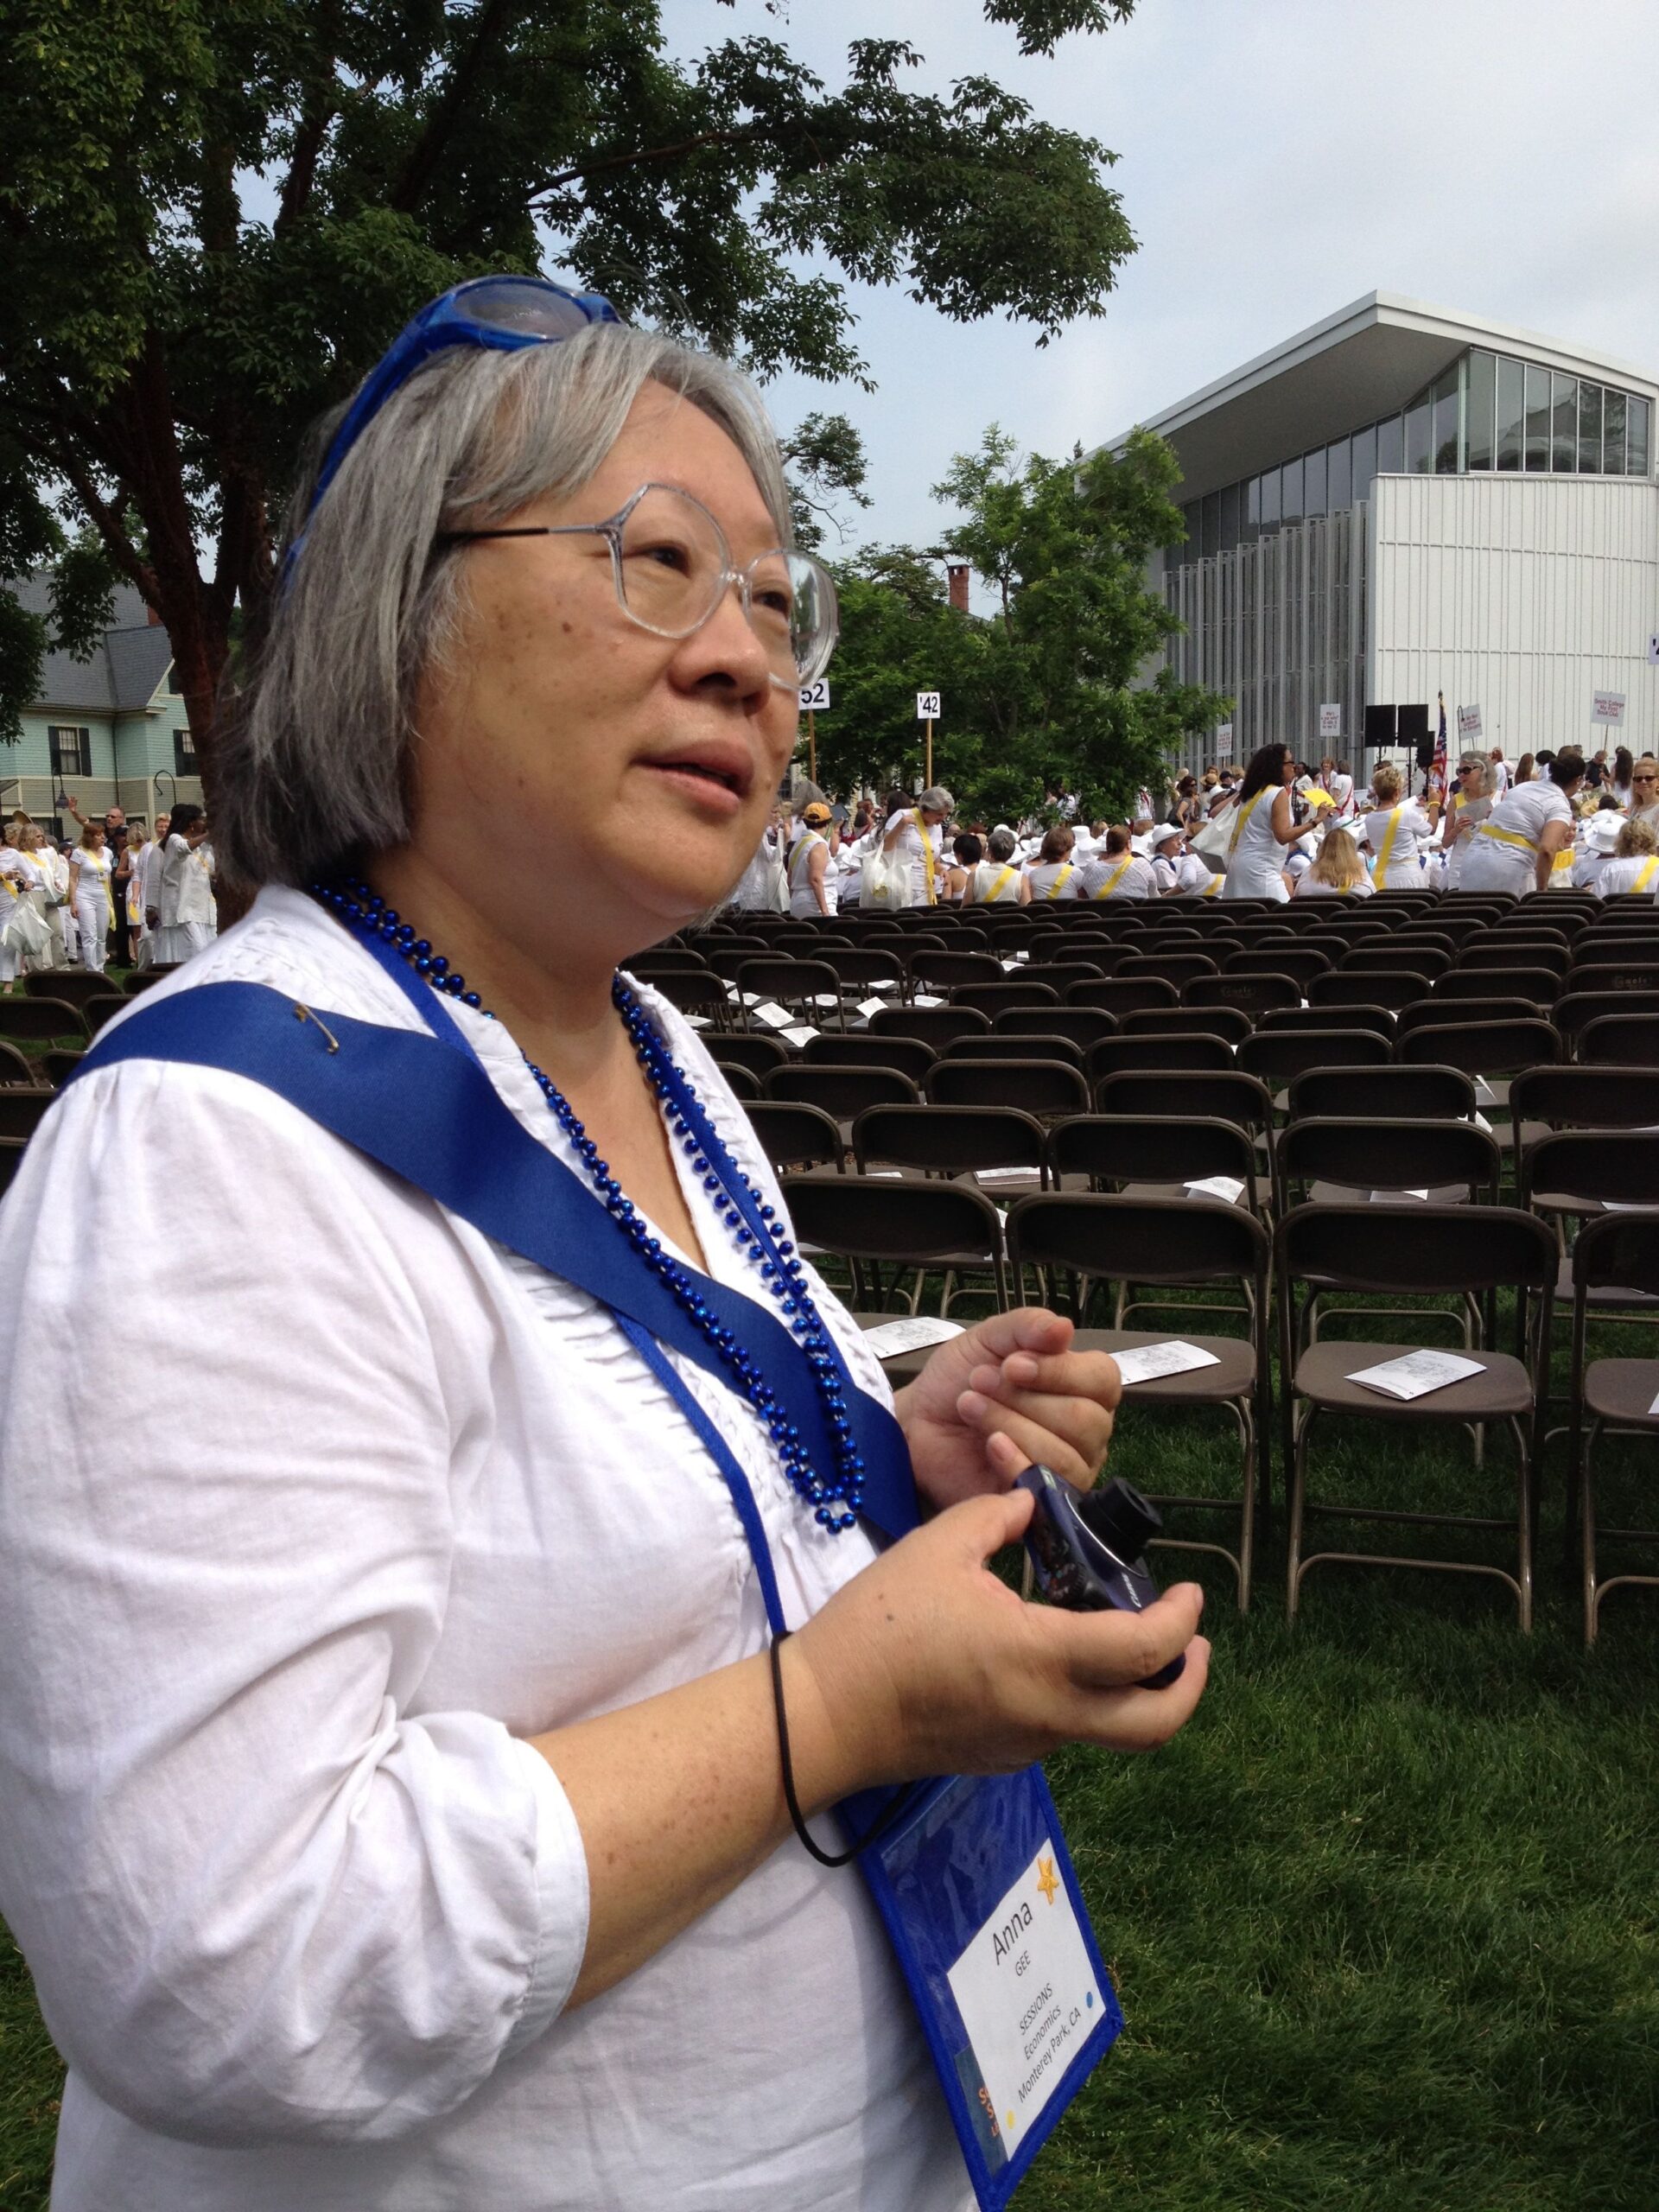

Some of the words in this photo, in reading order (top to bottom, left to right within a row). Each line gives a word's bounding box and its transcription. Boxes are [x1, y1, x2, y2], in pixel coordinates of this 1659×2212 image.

[919, 696, 938, 714] '42
[993, 1902, 1033, 1966] Anna
[1014, 1949, 1031, 1977] GEE
[1019, 1982, 1053, 2036] SESSIONS
[1024, 2005, 1061, 2061] Economics
[1018, 2048, 1053, 2103] Monterey
[1050, 2024, 1071, 2054] Park,
[1069, 2006, 1082, 2026] CA
